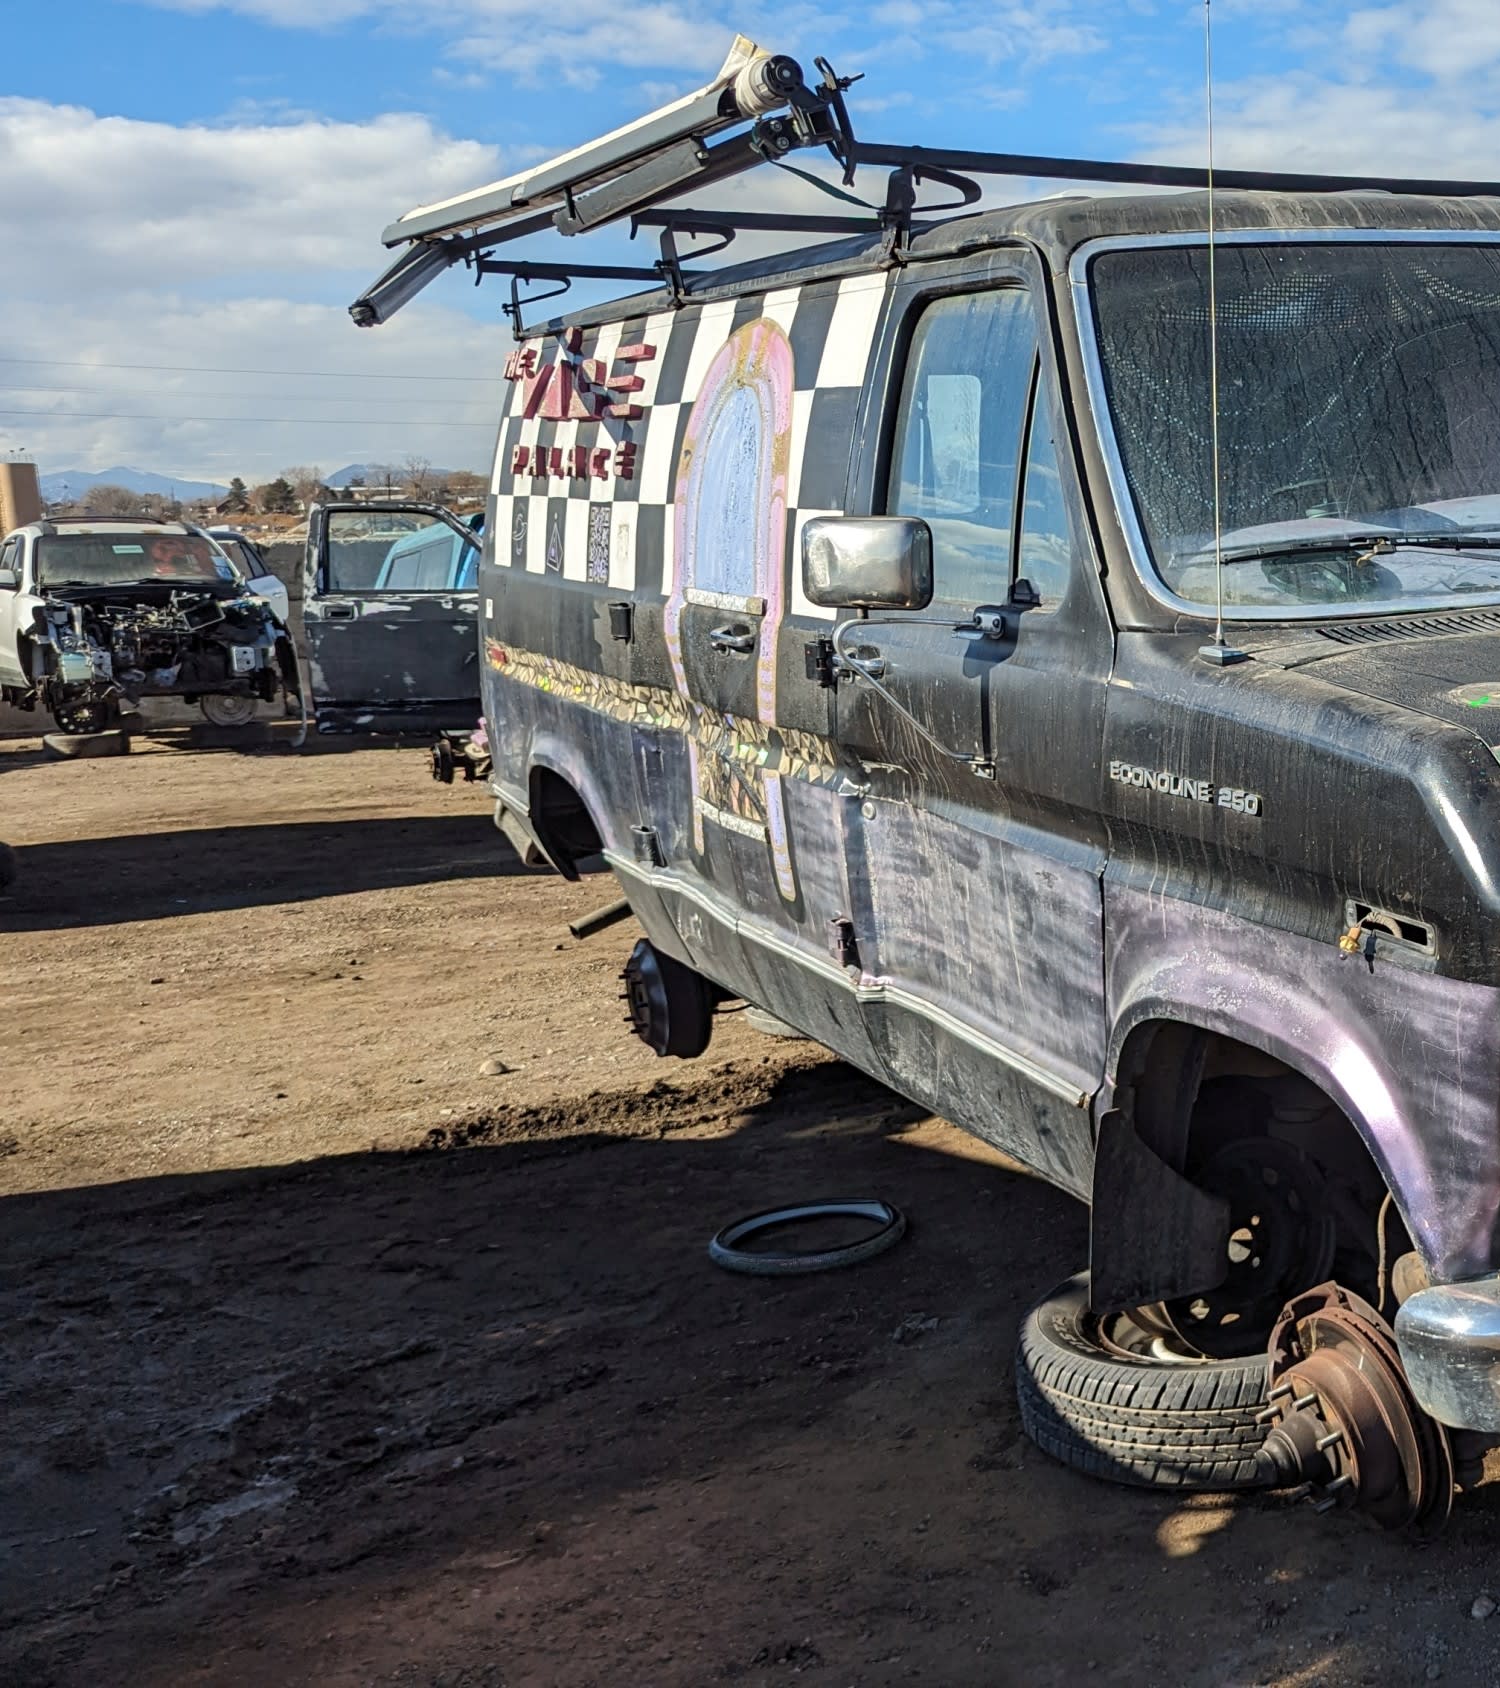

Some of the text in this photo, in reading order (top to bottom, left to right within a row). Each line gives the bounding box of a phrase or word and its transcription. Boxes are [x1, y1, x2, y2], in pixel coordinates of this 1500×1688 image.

[503, 348, 538, 381] THE
[510, 440, 638, 481] PALACE
[1109, 760, 1264, 818] ECONOLINE 250
